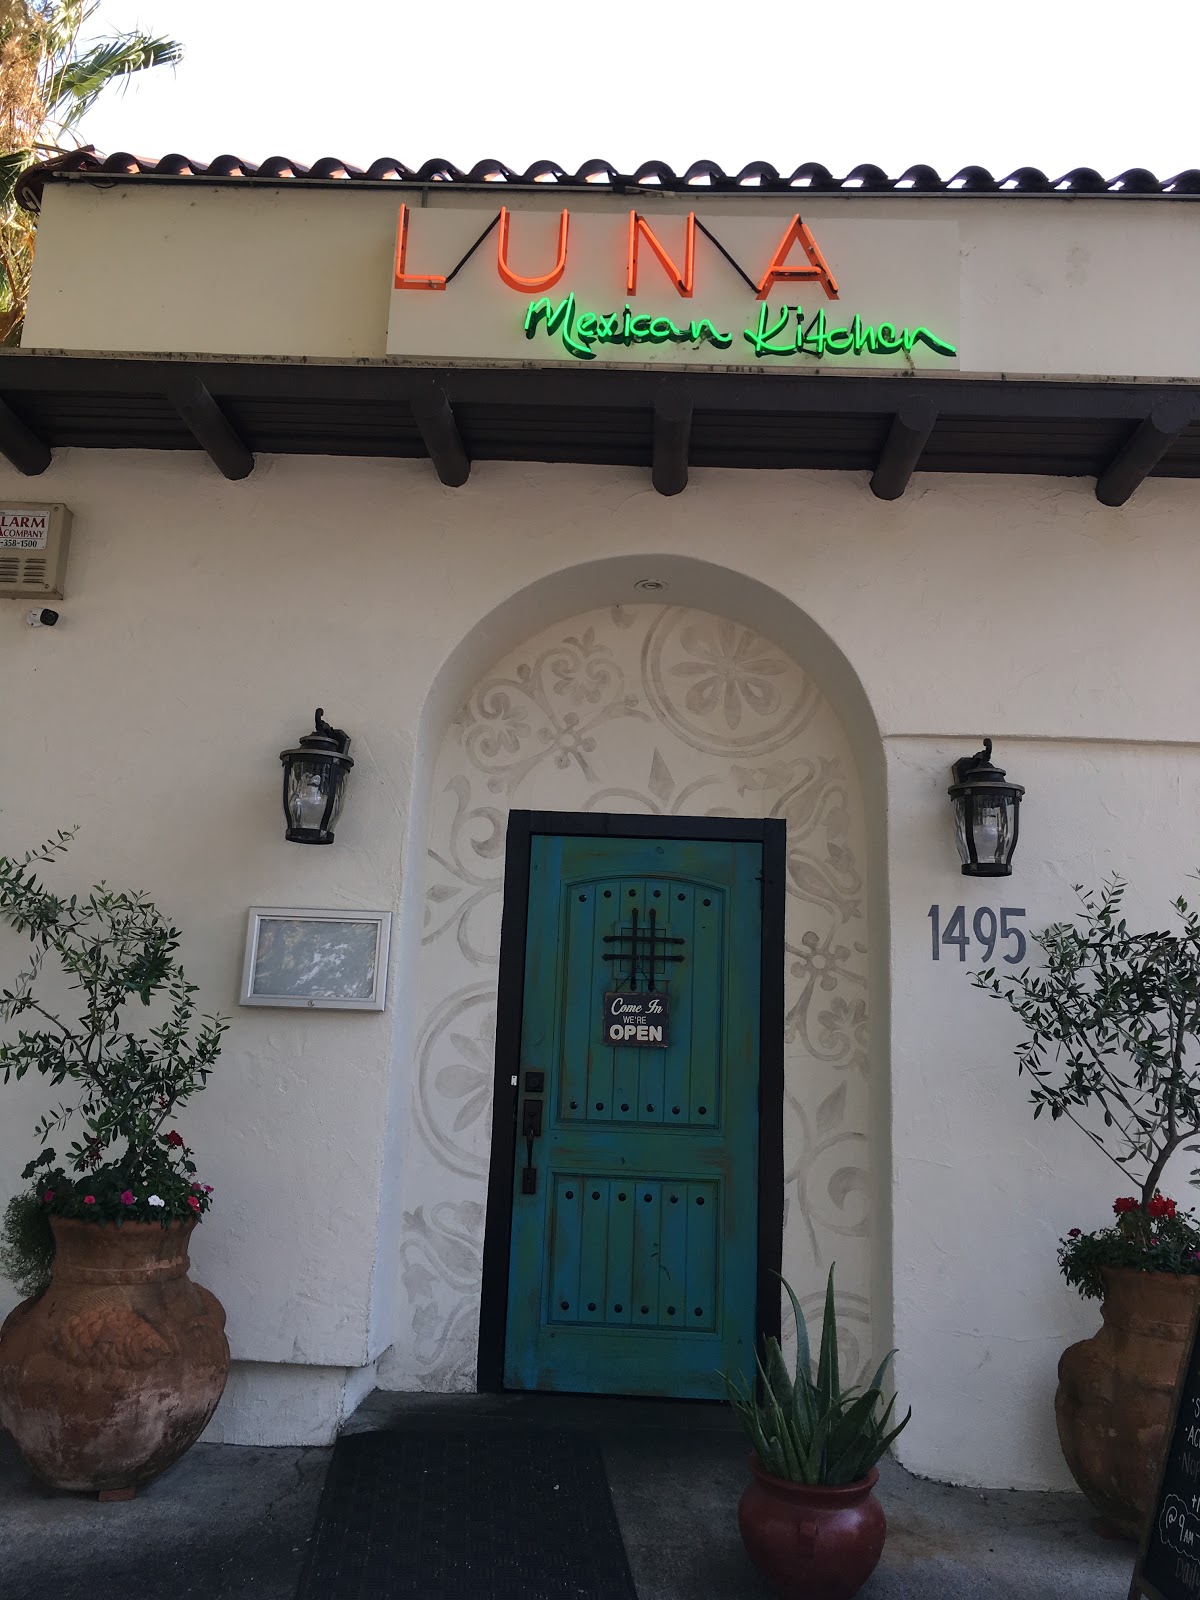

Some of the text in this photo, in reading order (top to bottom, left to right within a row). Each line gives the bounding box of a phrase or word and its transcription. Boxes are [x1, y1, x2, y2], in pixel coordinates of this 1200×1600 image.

[394, 202, 840, 300] LUNA
[524, 292, 957, 359] Mexican Kitchen
[0, 516, 45, 528] LARM
[4, 528, 44, 538] COMPANY
[927, 904, 1027, 965] 1495
[611, 997, 664, 1016] Come In
[623, 1016, 646, 1024] WE'RE
[609, 1024, 663, 1042] OPEN
